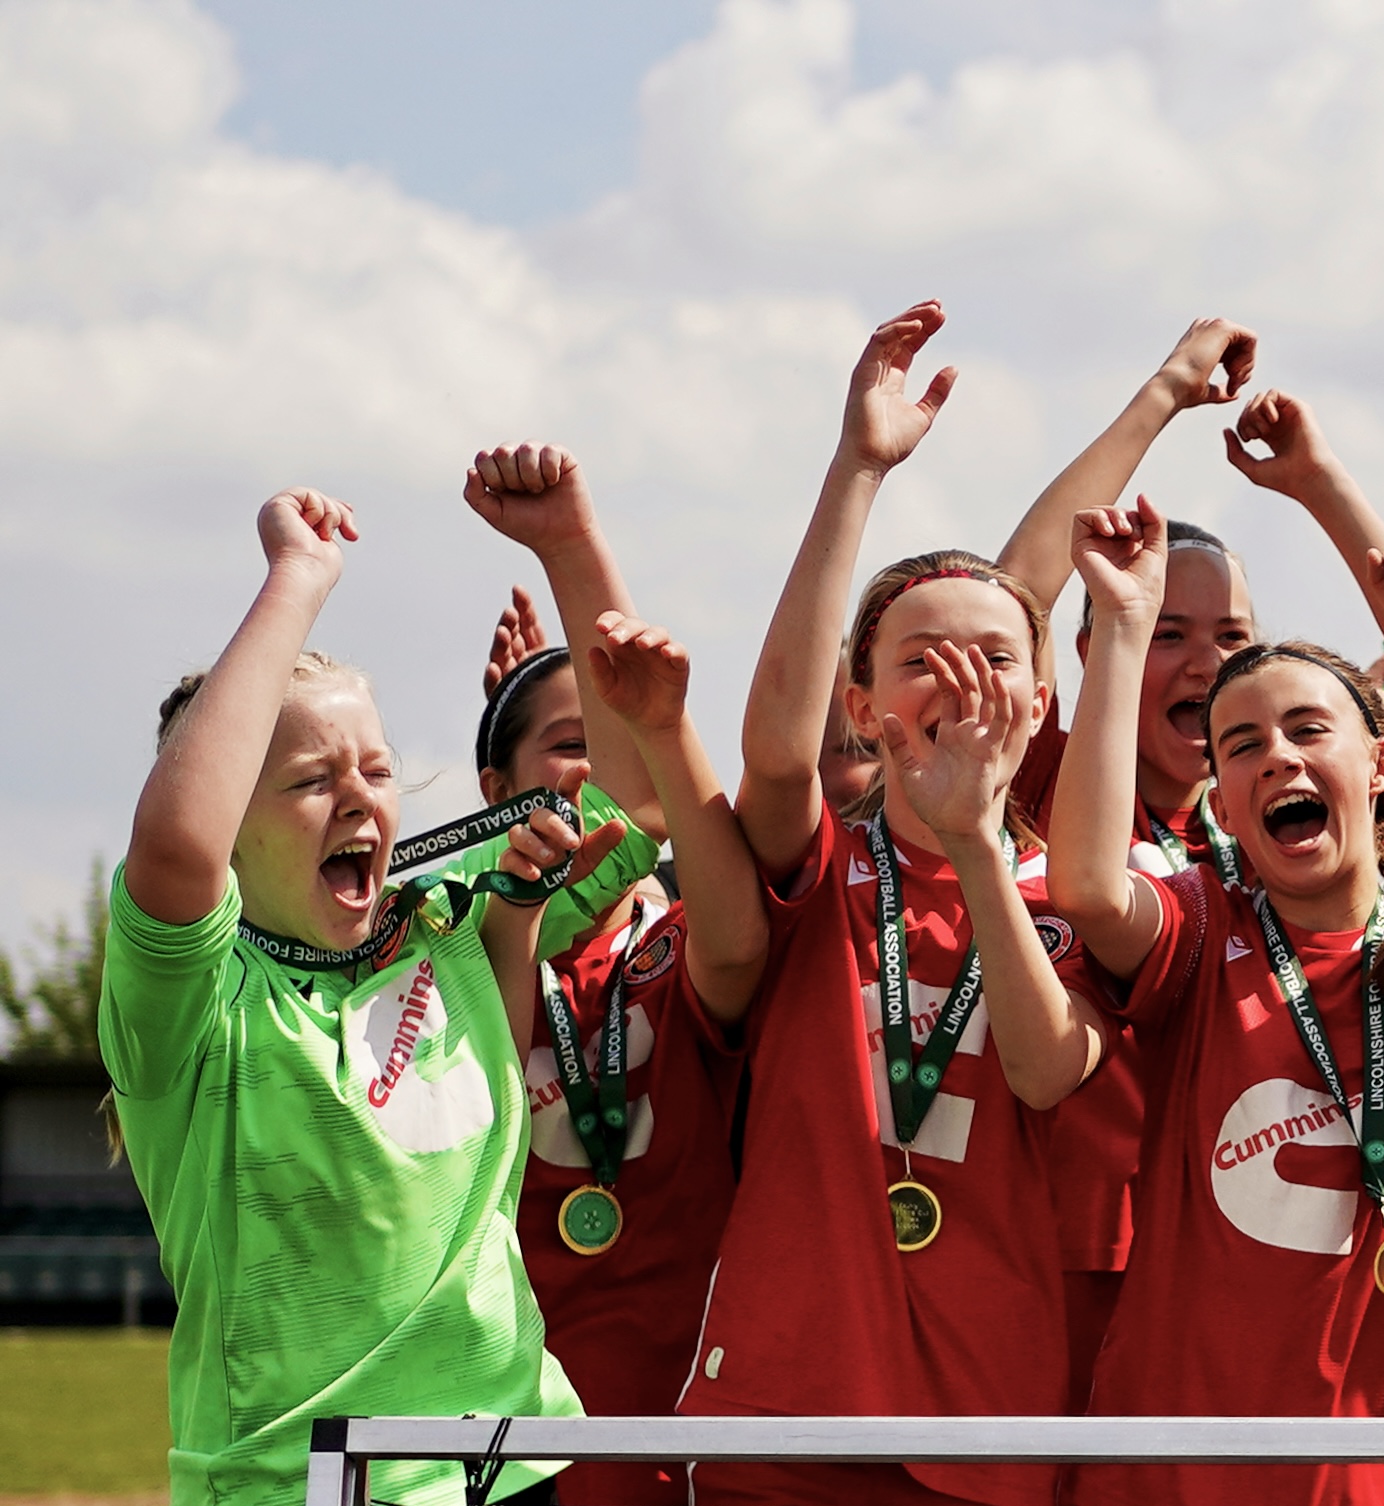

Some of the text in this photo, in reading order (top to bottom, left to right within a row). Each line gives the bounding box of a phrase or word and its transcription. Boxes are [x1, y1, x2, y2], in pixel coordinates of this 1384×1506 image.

[876, 852, 896, 921] FOOTBALL
[883, 922, 904, 1026] ASSOCIATION
[943, 950, 982, 1035] LINCOLNS
[1273, 945, 1307, 1019] FOOTBALL
[1300, 1015, 1347, 1105] ASSOCIATION
[368, 957, 436, 1110] Cummins
[1369, 1004, 1384, 1111] LINCOLNSHIRE
